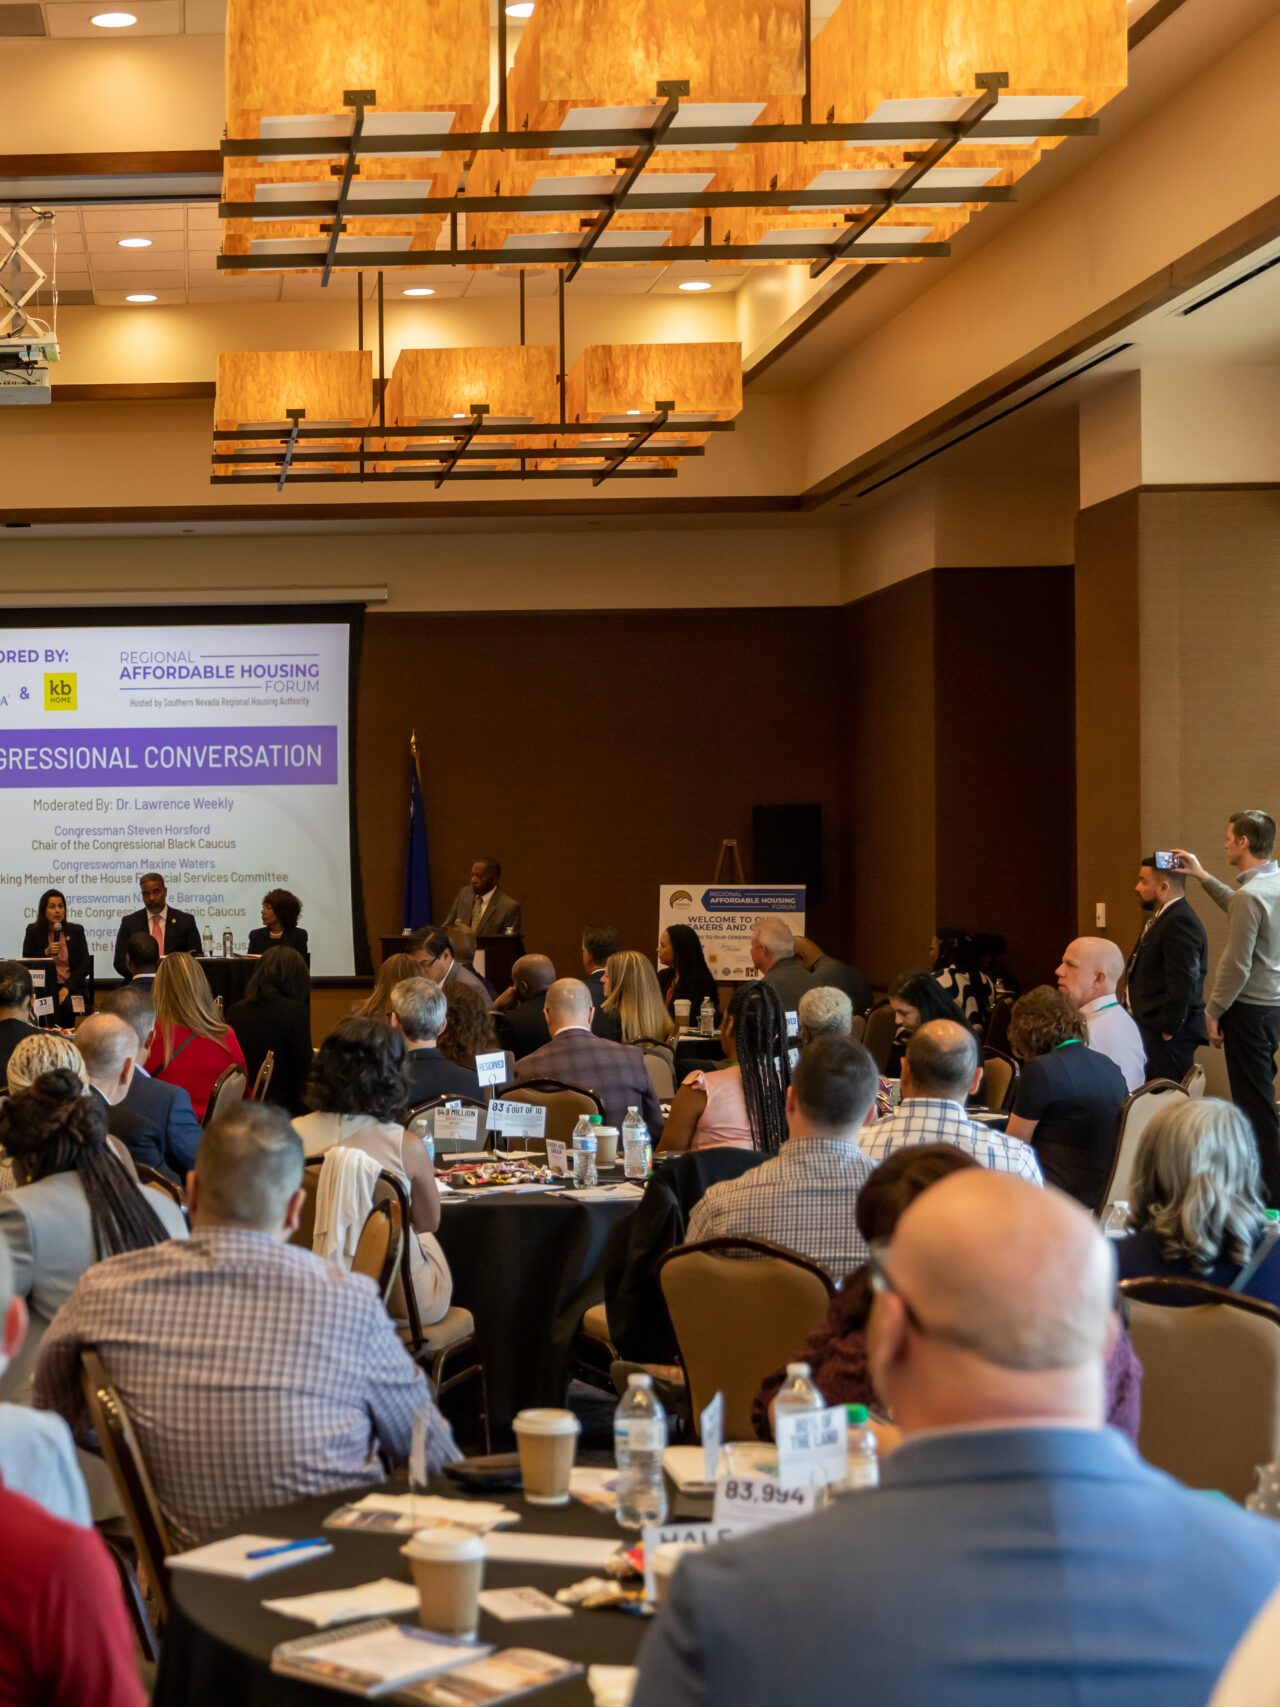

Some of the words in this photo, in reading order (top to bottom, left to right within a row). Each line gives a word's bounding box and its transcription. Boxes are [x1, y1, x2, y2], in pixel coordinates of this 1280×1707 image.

[44, 649, 69, 662] BY:
[120, 651, 195, 664] REGIONAL
[119, 665, 235, 680] AFFORDABLE
[240, 664, 320, 679] HOUSING
[19, 686, 30, 699] &
[49, 680, 72, 695] kb
[265, 680, 320, 692] FORUM
[130, 698, 152, 707] Hosted
[154, 699, 162, 709] by
[163, 698, 193, 707] Southern
[195, 698, 220, 707] Nevada
[221, 697, 249, 708] Regional
[251, 697, 278, 708] Housing
[279, 696, 310, 707] Authority
[144, 744, 322, 769] CONVERSATION
[33, 799, 93, 811] Moderated
[96, 799, 113, 813] By:
[116, 798, 132, 811] Dr.
[134, 798, 190, 810] Lawrence
[193, 798, 234, 812] Weekly
[54, 825, 125, 838] Congressman
[127, 825, 163, 836] Steven
[165, 824, 211, 835] Horsford
[31, 839, 58, 851] Chair
[60, 839, 71, 850] of
[73, 839, 90, 850] the
[92, 839, 165, 852] Congressional
[167, 838, 196, 849] Black
[198, 838, 236, 849] Caucus
[52, 859, 138, 872] Congresswoman
[140, 858, 176, 869] Maxine
[179, 857, 216, 869] Waters
[24, 873, 65, 884] Member
[68, 873, 79, 884] of
[81, 873, 98, 884] the
[100, 872, 132, 883] House
[135, 871, 181, 883] Fcial
[183, 871, 229, 883] Services
[231, 871, 289, 883] Committee
[66, 893, 131, 905] gresswoman
[177, 892, 224, 905] Barragán
[207, 906, 246, 917] Caucus
[688, 916, 737, 924] WELCOME
[479, 1060, 504, 1072] RESERVED
[450, 1109, 476, 1117] MILLION
[511, 1106, 524, 1114] OUT
[525, 1106, 533, 1114] OF
